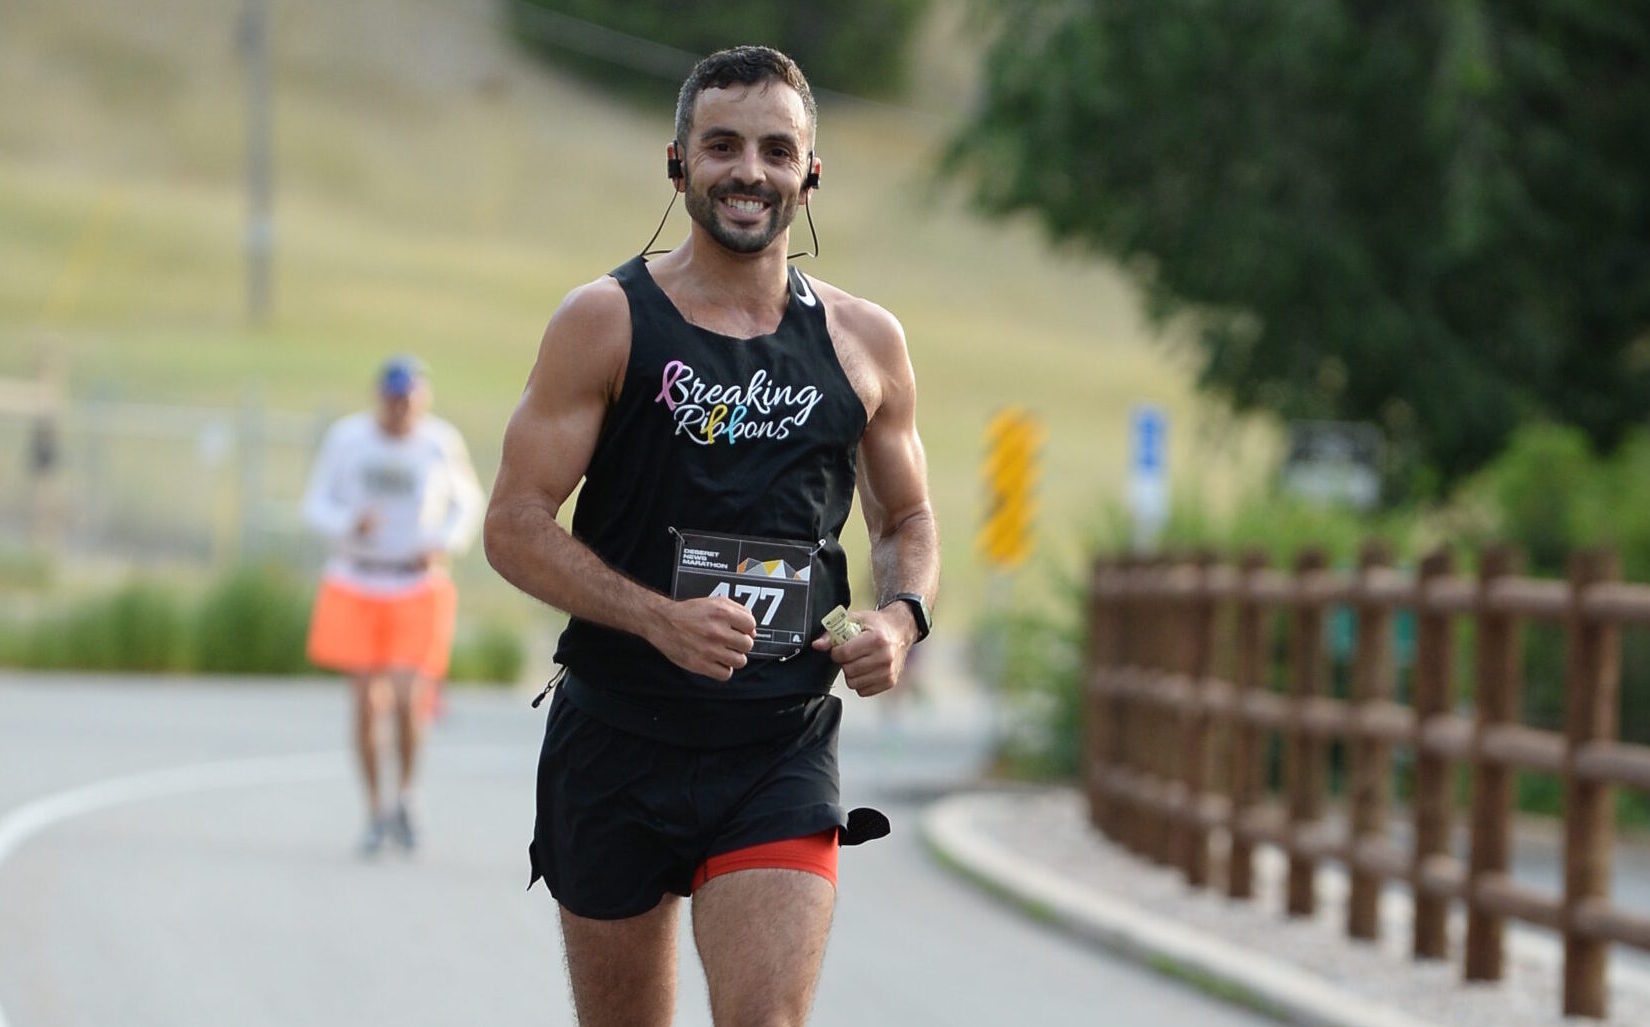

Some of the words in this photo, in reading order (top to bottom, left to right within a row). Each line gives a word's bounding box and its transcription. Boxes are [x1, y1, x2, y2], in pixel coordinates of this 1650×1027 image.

[654, 360, 823, 426] Breaking
[674, 404, 793, 445] Ribbons
[682, 559, 729, 569] MARATHON
[683, 548, 720, 557] DESERET
